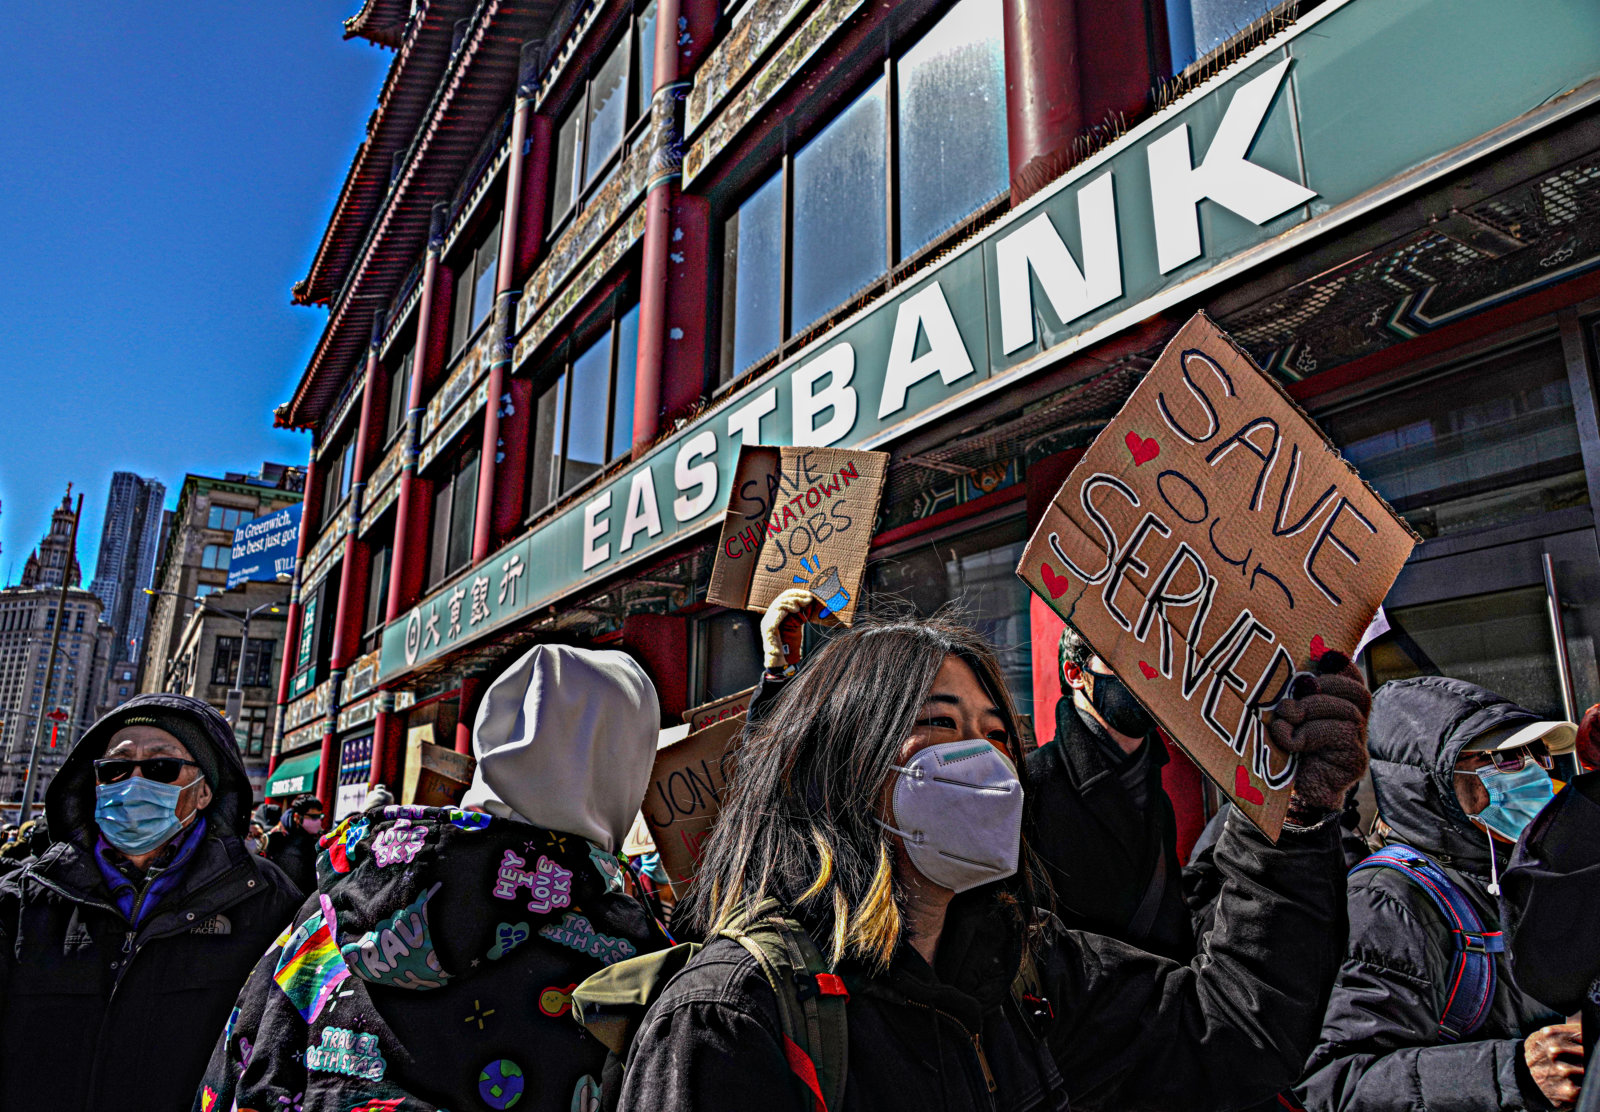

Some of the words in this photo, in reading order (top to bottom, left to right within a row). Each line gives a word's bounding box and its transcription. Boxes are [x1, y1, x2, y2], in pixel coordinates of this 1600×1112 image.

[740, 450, 823, 520] SAVE
[1156, 348, 1377, 606] SAVE
[234, 528, 244, 543] In
[244, 510, 292, 539] Greenwich,
[725, 461, 860, 559] CHINATOWN
[232, 543, 246, 560] the
[246, 538, 264, 555] best
[264, 532, 281, 552] just
[281, 526, 297, 547] got
[765, 500, 852, 572] JOBS
[1048, 472, 1318, 790] SERVERS
[374, 828, 426, 850] LOVE
[378, 845, 418, 864] SKY
[496, 853, 523, 897] HEY
[517, 873, 534, 887] I
[531, 858, 554, 910] LOVE
[551, 866, 570, 905] SKY
[190, 926, 215, 935] FACE
[323, 1030, 378, 1058] TRAVEL
[307, 1048, 340, 1069] WITH
[340, 1054, 384, 1077] STAR
